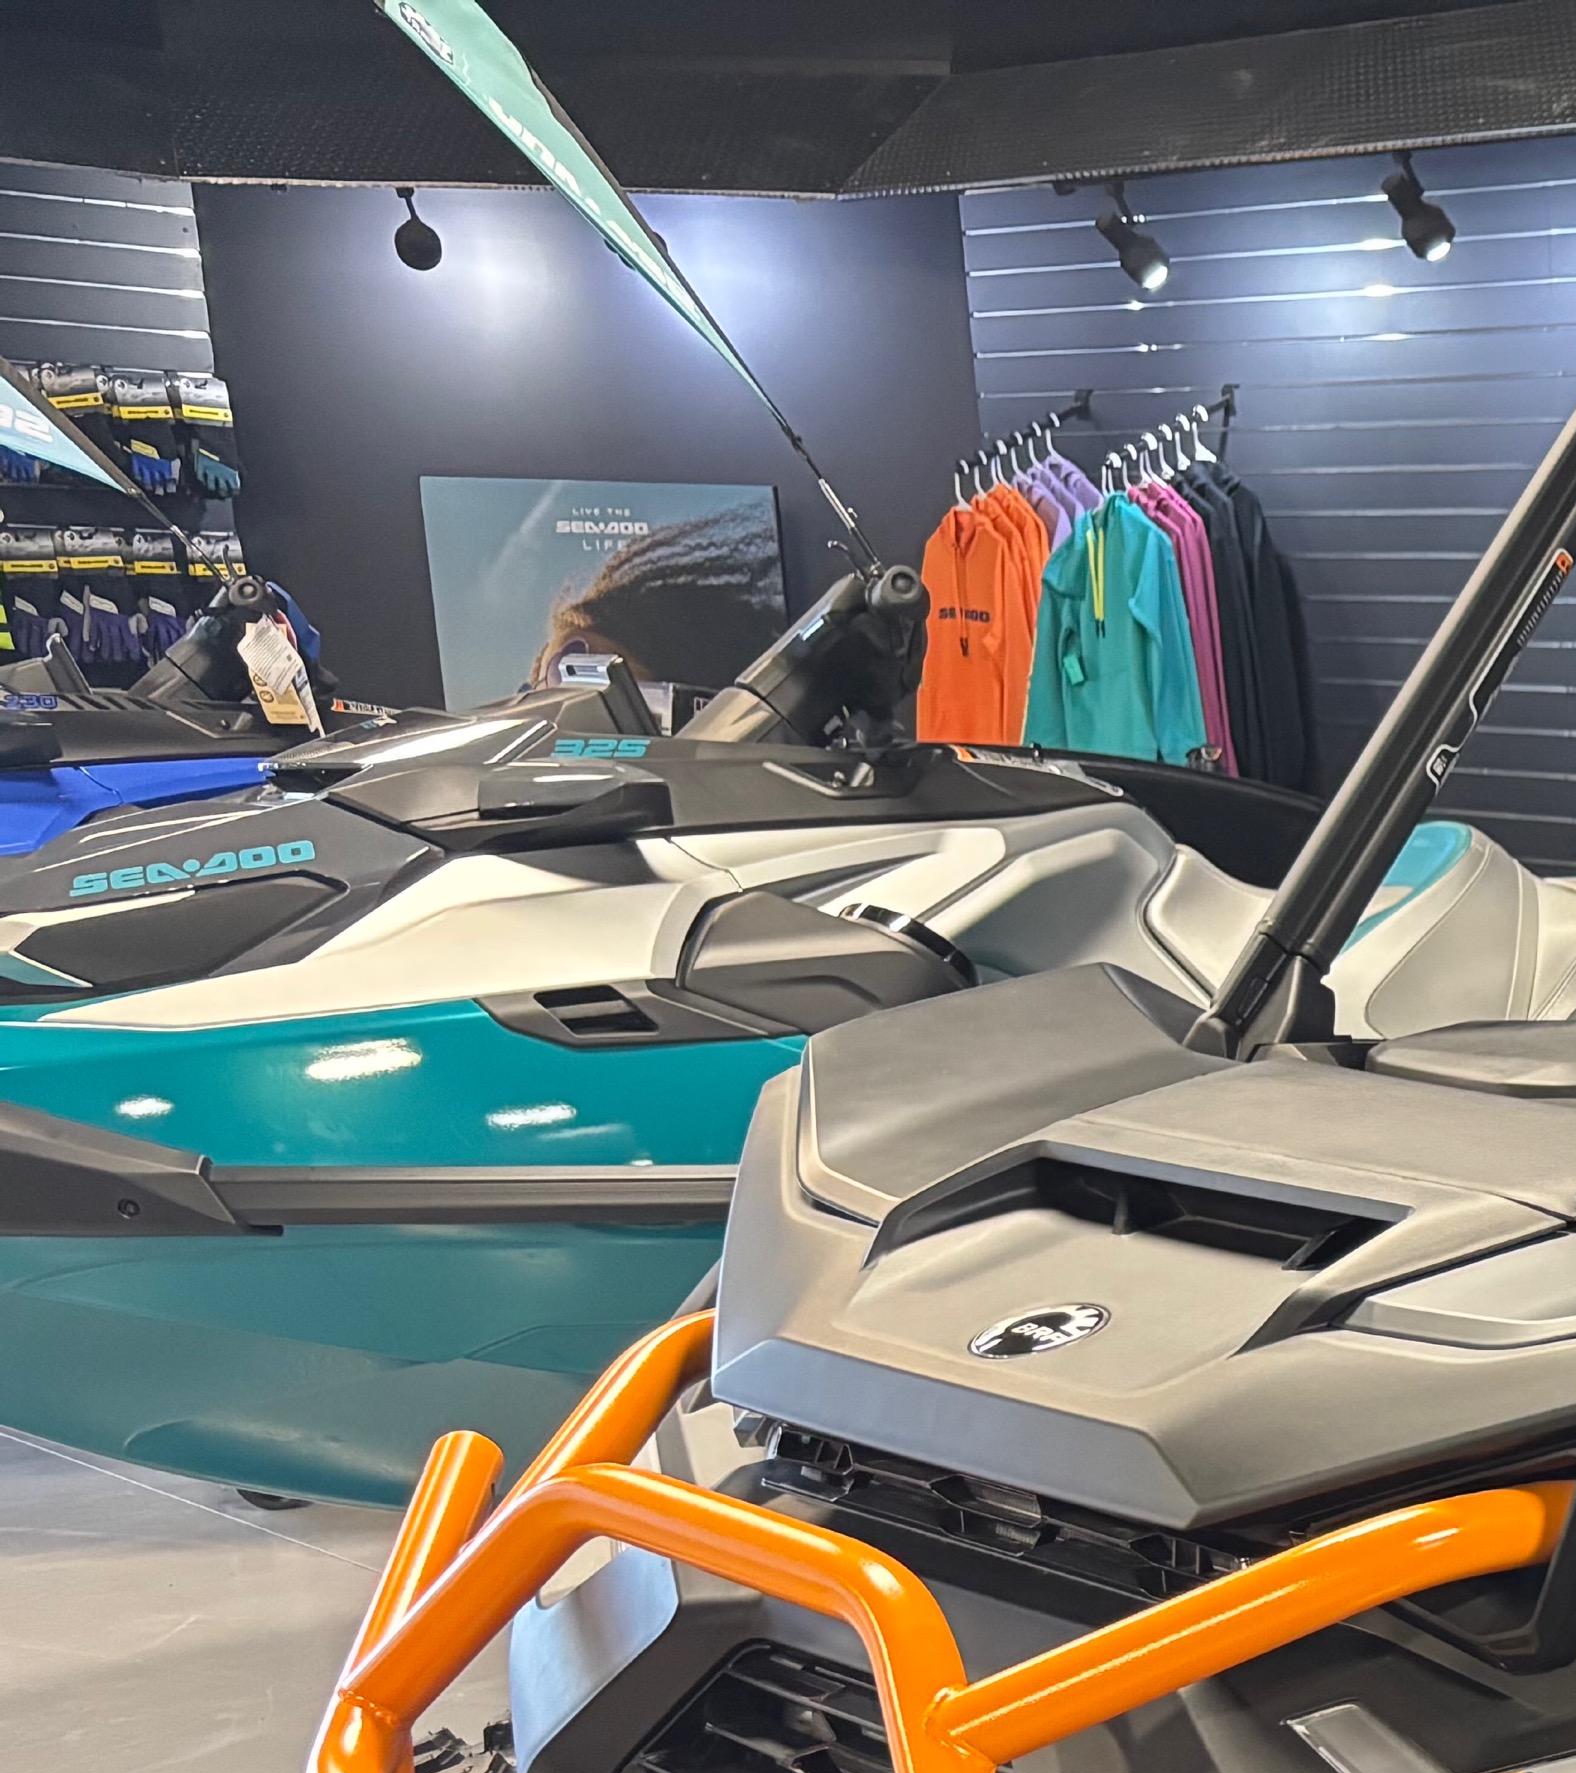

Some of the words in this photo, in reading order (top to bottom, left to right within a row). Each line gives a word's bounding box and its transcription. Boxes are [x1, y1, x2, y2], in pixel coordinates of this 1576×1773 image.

[571, 507, 601, 517] LIVE
[606, 507, 632, 517] THE
[582, 539, 631, 551] LIFE
[551, 738, 651, 758] 325
